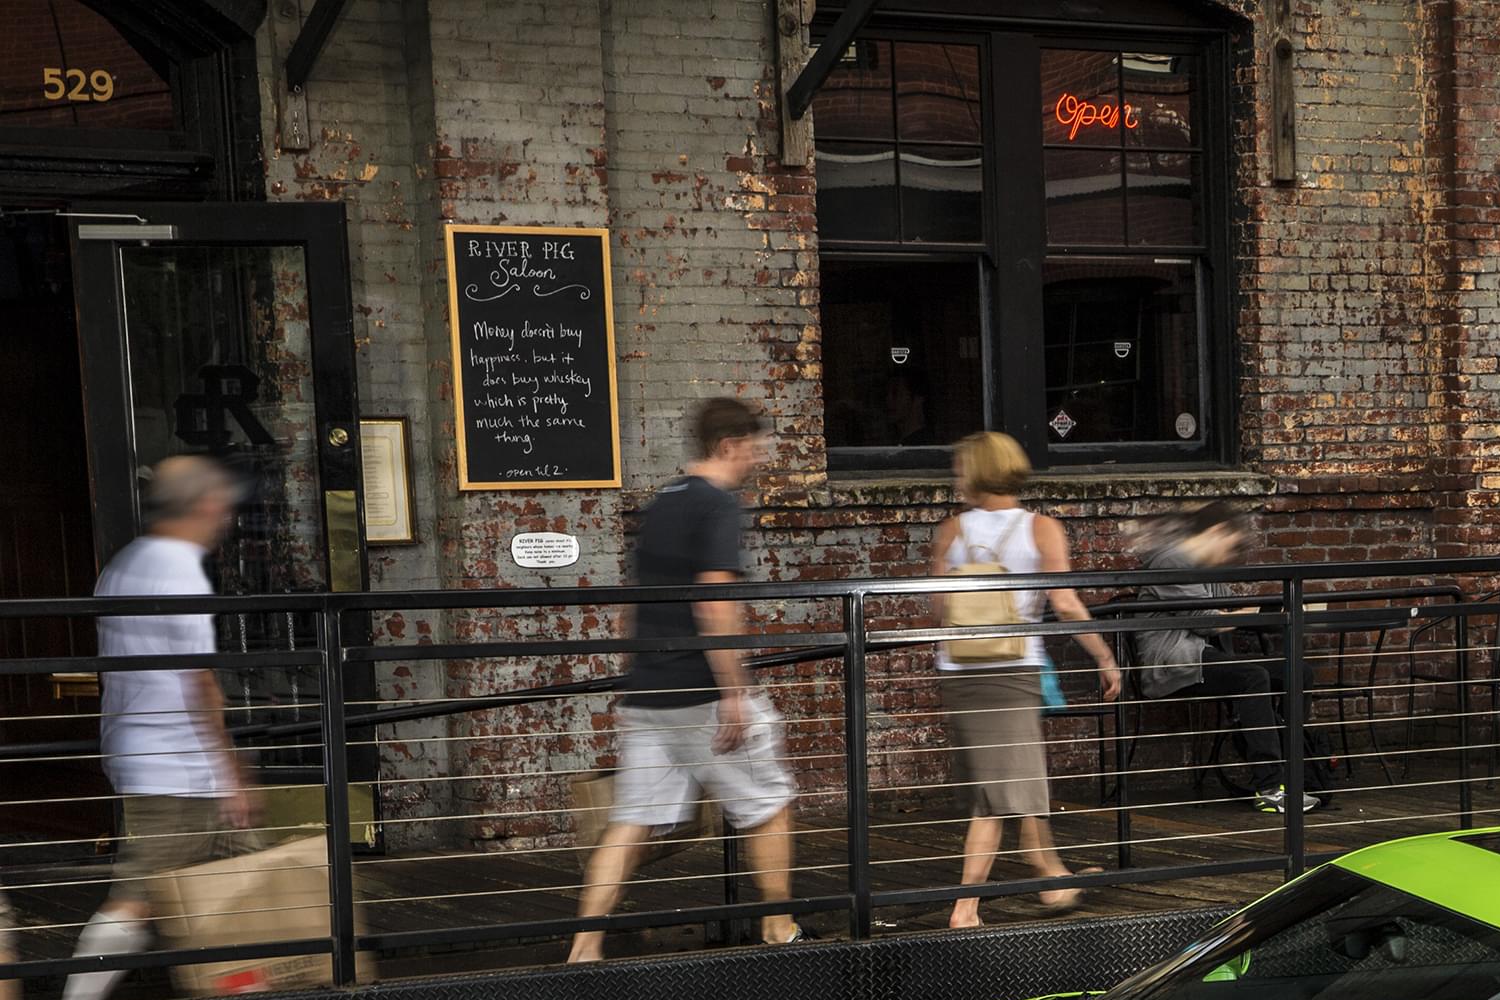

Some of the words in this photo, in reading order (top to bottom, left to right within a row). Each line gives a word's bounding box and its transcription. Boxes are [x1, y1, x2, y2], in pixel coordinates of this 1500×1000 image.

[43, 67, 114, 102] 529
[1056, 92, 1139, 140] Open
[468, 239, 533, 259] RIVER
[542, 241, 576, 261] PIG
[489, 258, 556, 288] Saloon
[473, 320, 515, 352] Money
[521, 319, 556, 340] doesn't
[559, 322, 583, 349] buy
[532, 348, 557, 365] but
[561, 351, 575, 365] it
[482, 373, 507, 387] does
[512, 372, 540, 394] buy
[543, 369, 592, 398] whiskey
[474, 393, 514, 409] which
[517, 395, 527, 407] is
[531, 392, 569, 415] pretty
[476, 416, 514, 429] much
[518, 415, 540, 428] the
[546, 417, 586, 428] same
